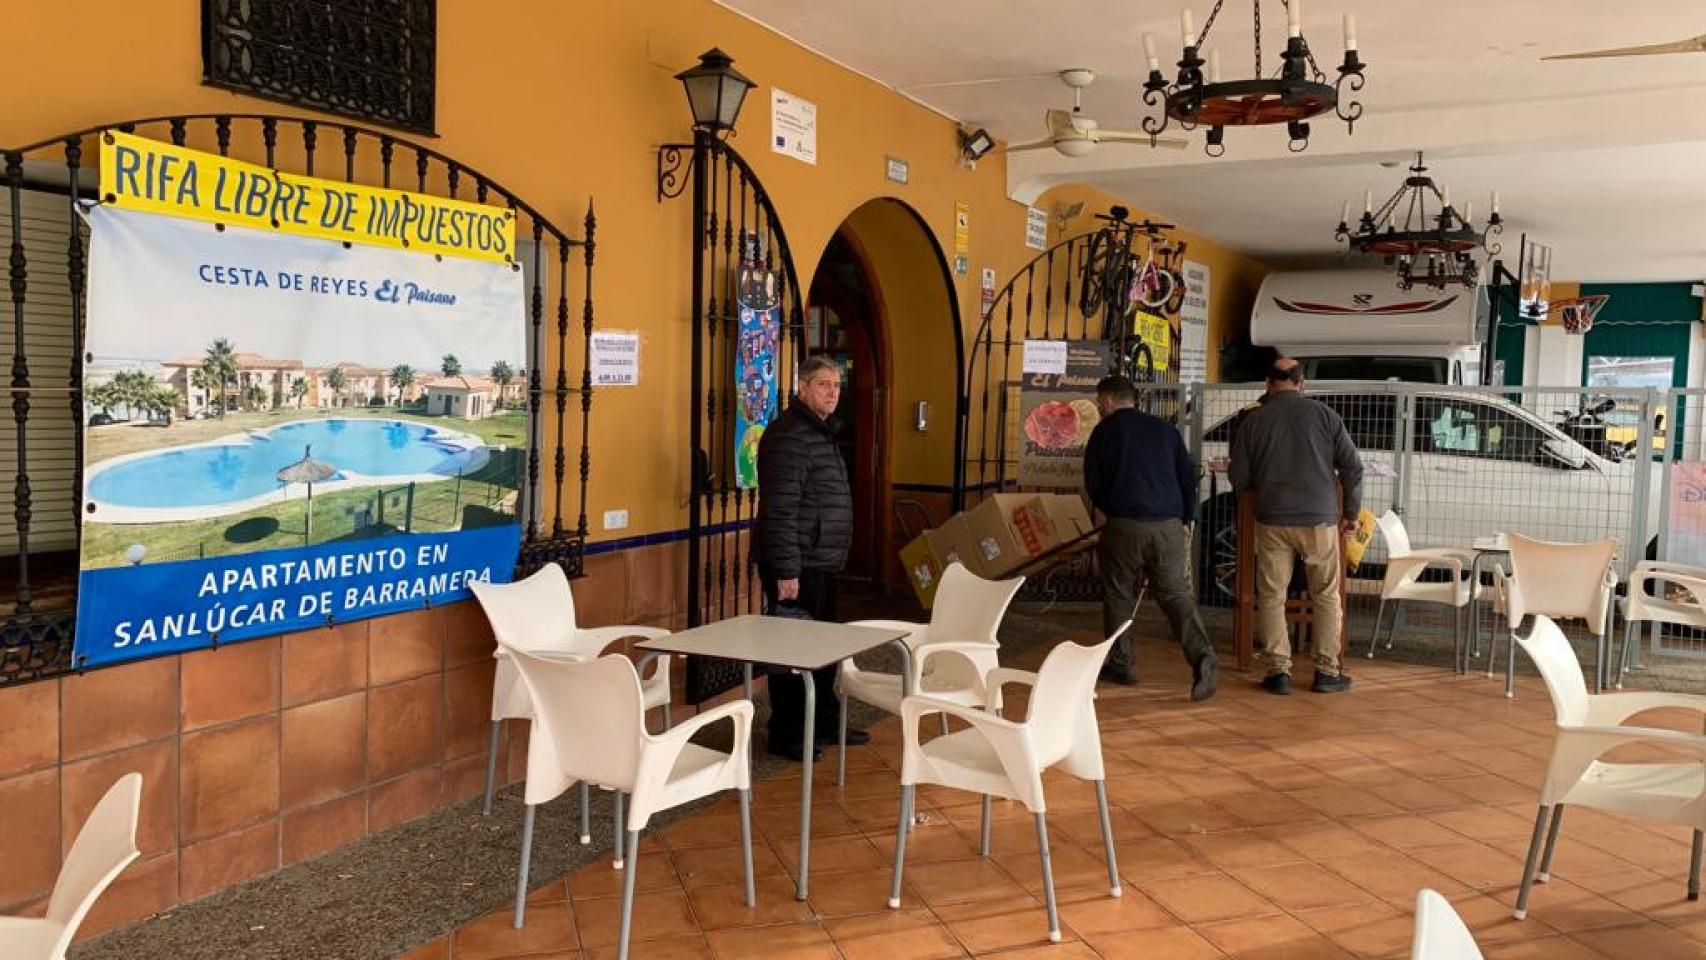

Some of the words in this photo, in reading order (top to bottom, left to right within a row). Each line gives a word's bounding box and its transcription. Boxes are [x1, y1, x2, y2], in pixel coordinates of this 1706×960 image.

[116, 146, 200, 207] RIFA
[214, 167, 311, 225] LIBRE
[320, 189, 358, 232] DE
[367, 198, 506, 253] IMPUESTOS
[199, 264, 269, 288] CESTA
[278, 272, 303, 291] DE
[310, 276, 368, 298] REYES
[374, 279, 399, 304] El
[198, 548, 406, 598] APARTAMENTO
[417, 542, 449, 567] EN
[113, 602, 286, 648] SANLÚCAR
[298, 591, 334, 618] DE
